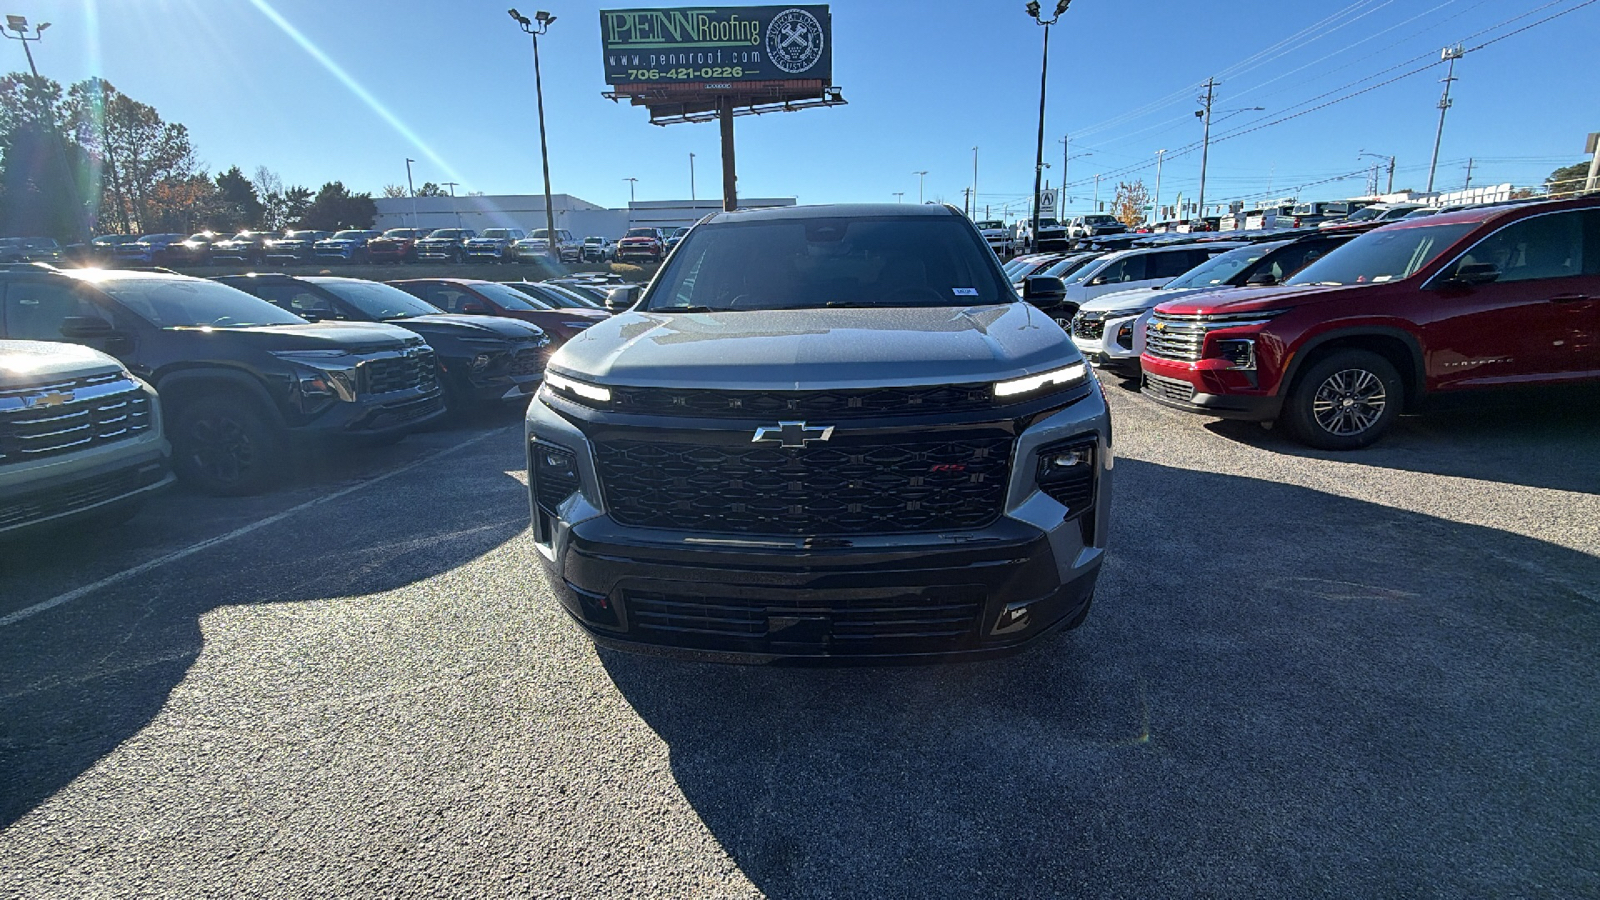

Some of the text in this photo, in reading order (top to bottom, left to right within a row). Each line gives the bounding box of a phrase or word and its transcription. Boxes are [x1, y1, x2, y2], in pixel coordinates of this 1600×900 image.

[605, 10, 760, 46] PENN Roofing
[609, 49, 761, 67] www.pennroof.com
[627, 66, 743, 80] 706-421-0226
